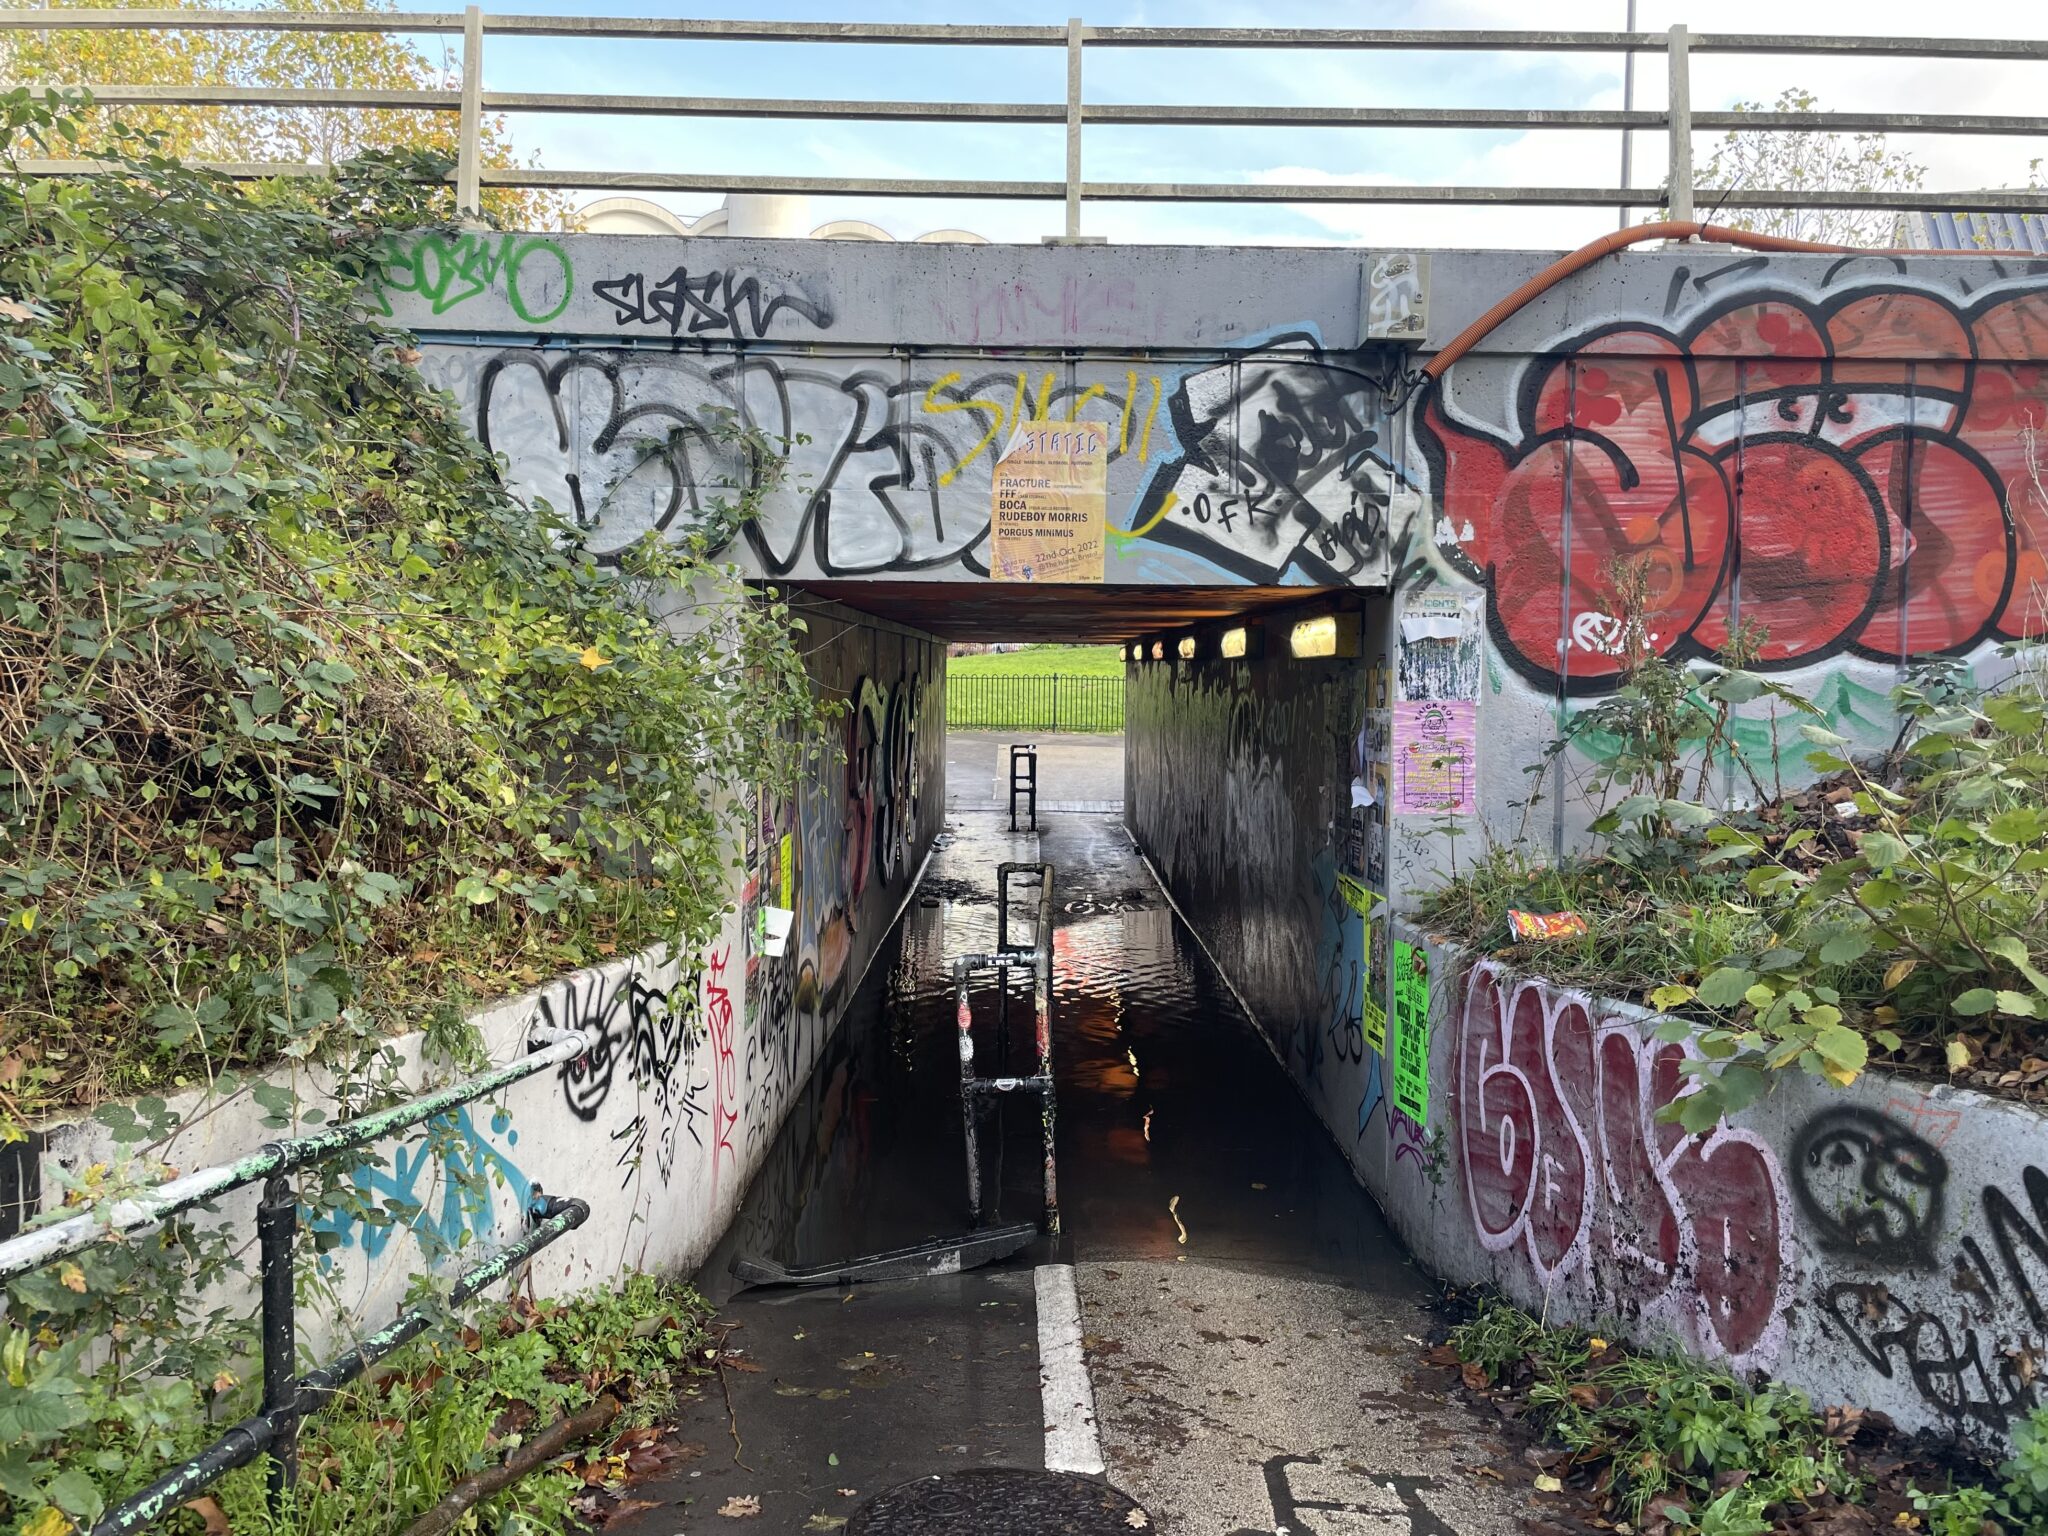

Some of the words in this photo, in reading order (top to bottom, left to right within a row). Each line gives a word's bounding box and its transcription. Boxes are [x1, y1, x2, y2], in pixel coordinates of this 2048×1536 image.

[1025, 431, 1097, 454] STATIC
[1000, 478, 1051, 488] FRACTURE
[1000, 489, 1017, 499] FFF
[1000, 500, 1027, 510] BOCA
[1000, 512, 1046, 521] RUDEBOY
[1049, 512, 1088, 523] MORRIS
[999, 528, 1033, 536] PORGUS
[1035, 529, 1074, 538] MINIMUS
[1035, 550, 1057, 563] 22nd
[1059, 547, 1076, 557] Oct
[1077, 540, 1099, 552] 2022
[1078, 551, 1098, 561] Bristol
